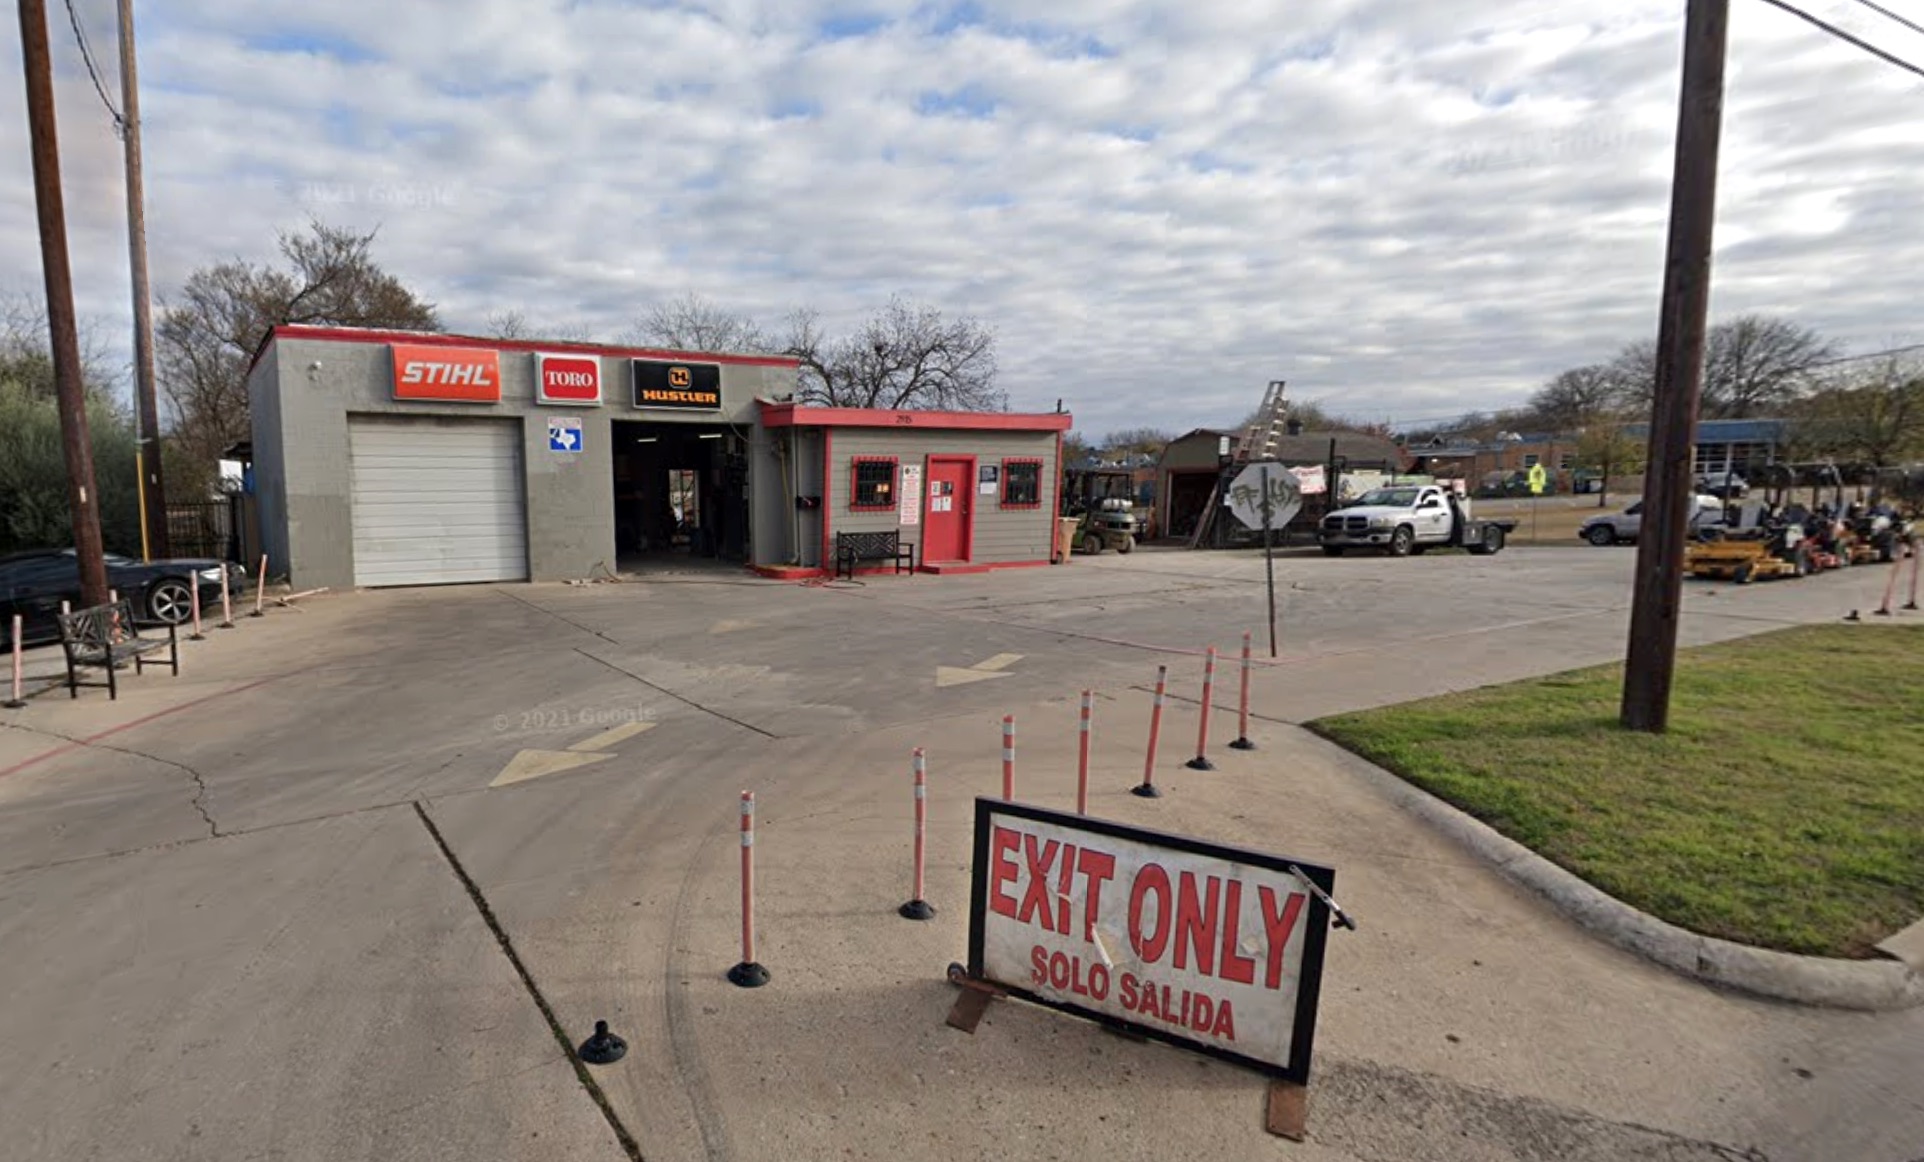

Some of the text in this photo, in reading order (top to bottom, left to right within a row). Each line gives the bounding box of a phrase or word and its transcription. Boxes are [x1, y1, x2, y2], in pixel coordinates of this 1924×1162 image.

[401, 361, 491, 387] STIHL
[545, 370, 594, 387] TORO
[643, 389, 717, 403] HUSTLER
[990, 825, 1306, 990] EXIT ONLY
[1031, 945, 1235, 1041] SOLO SALIDA
